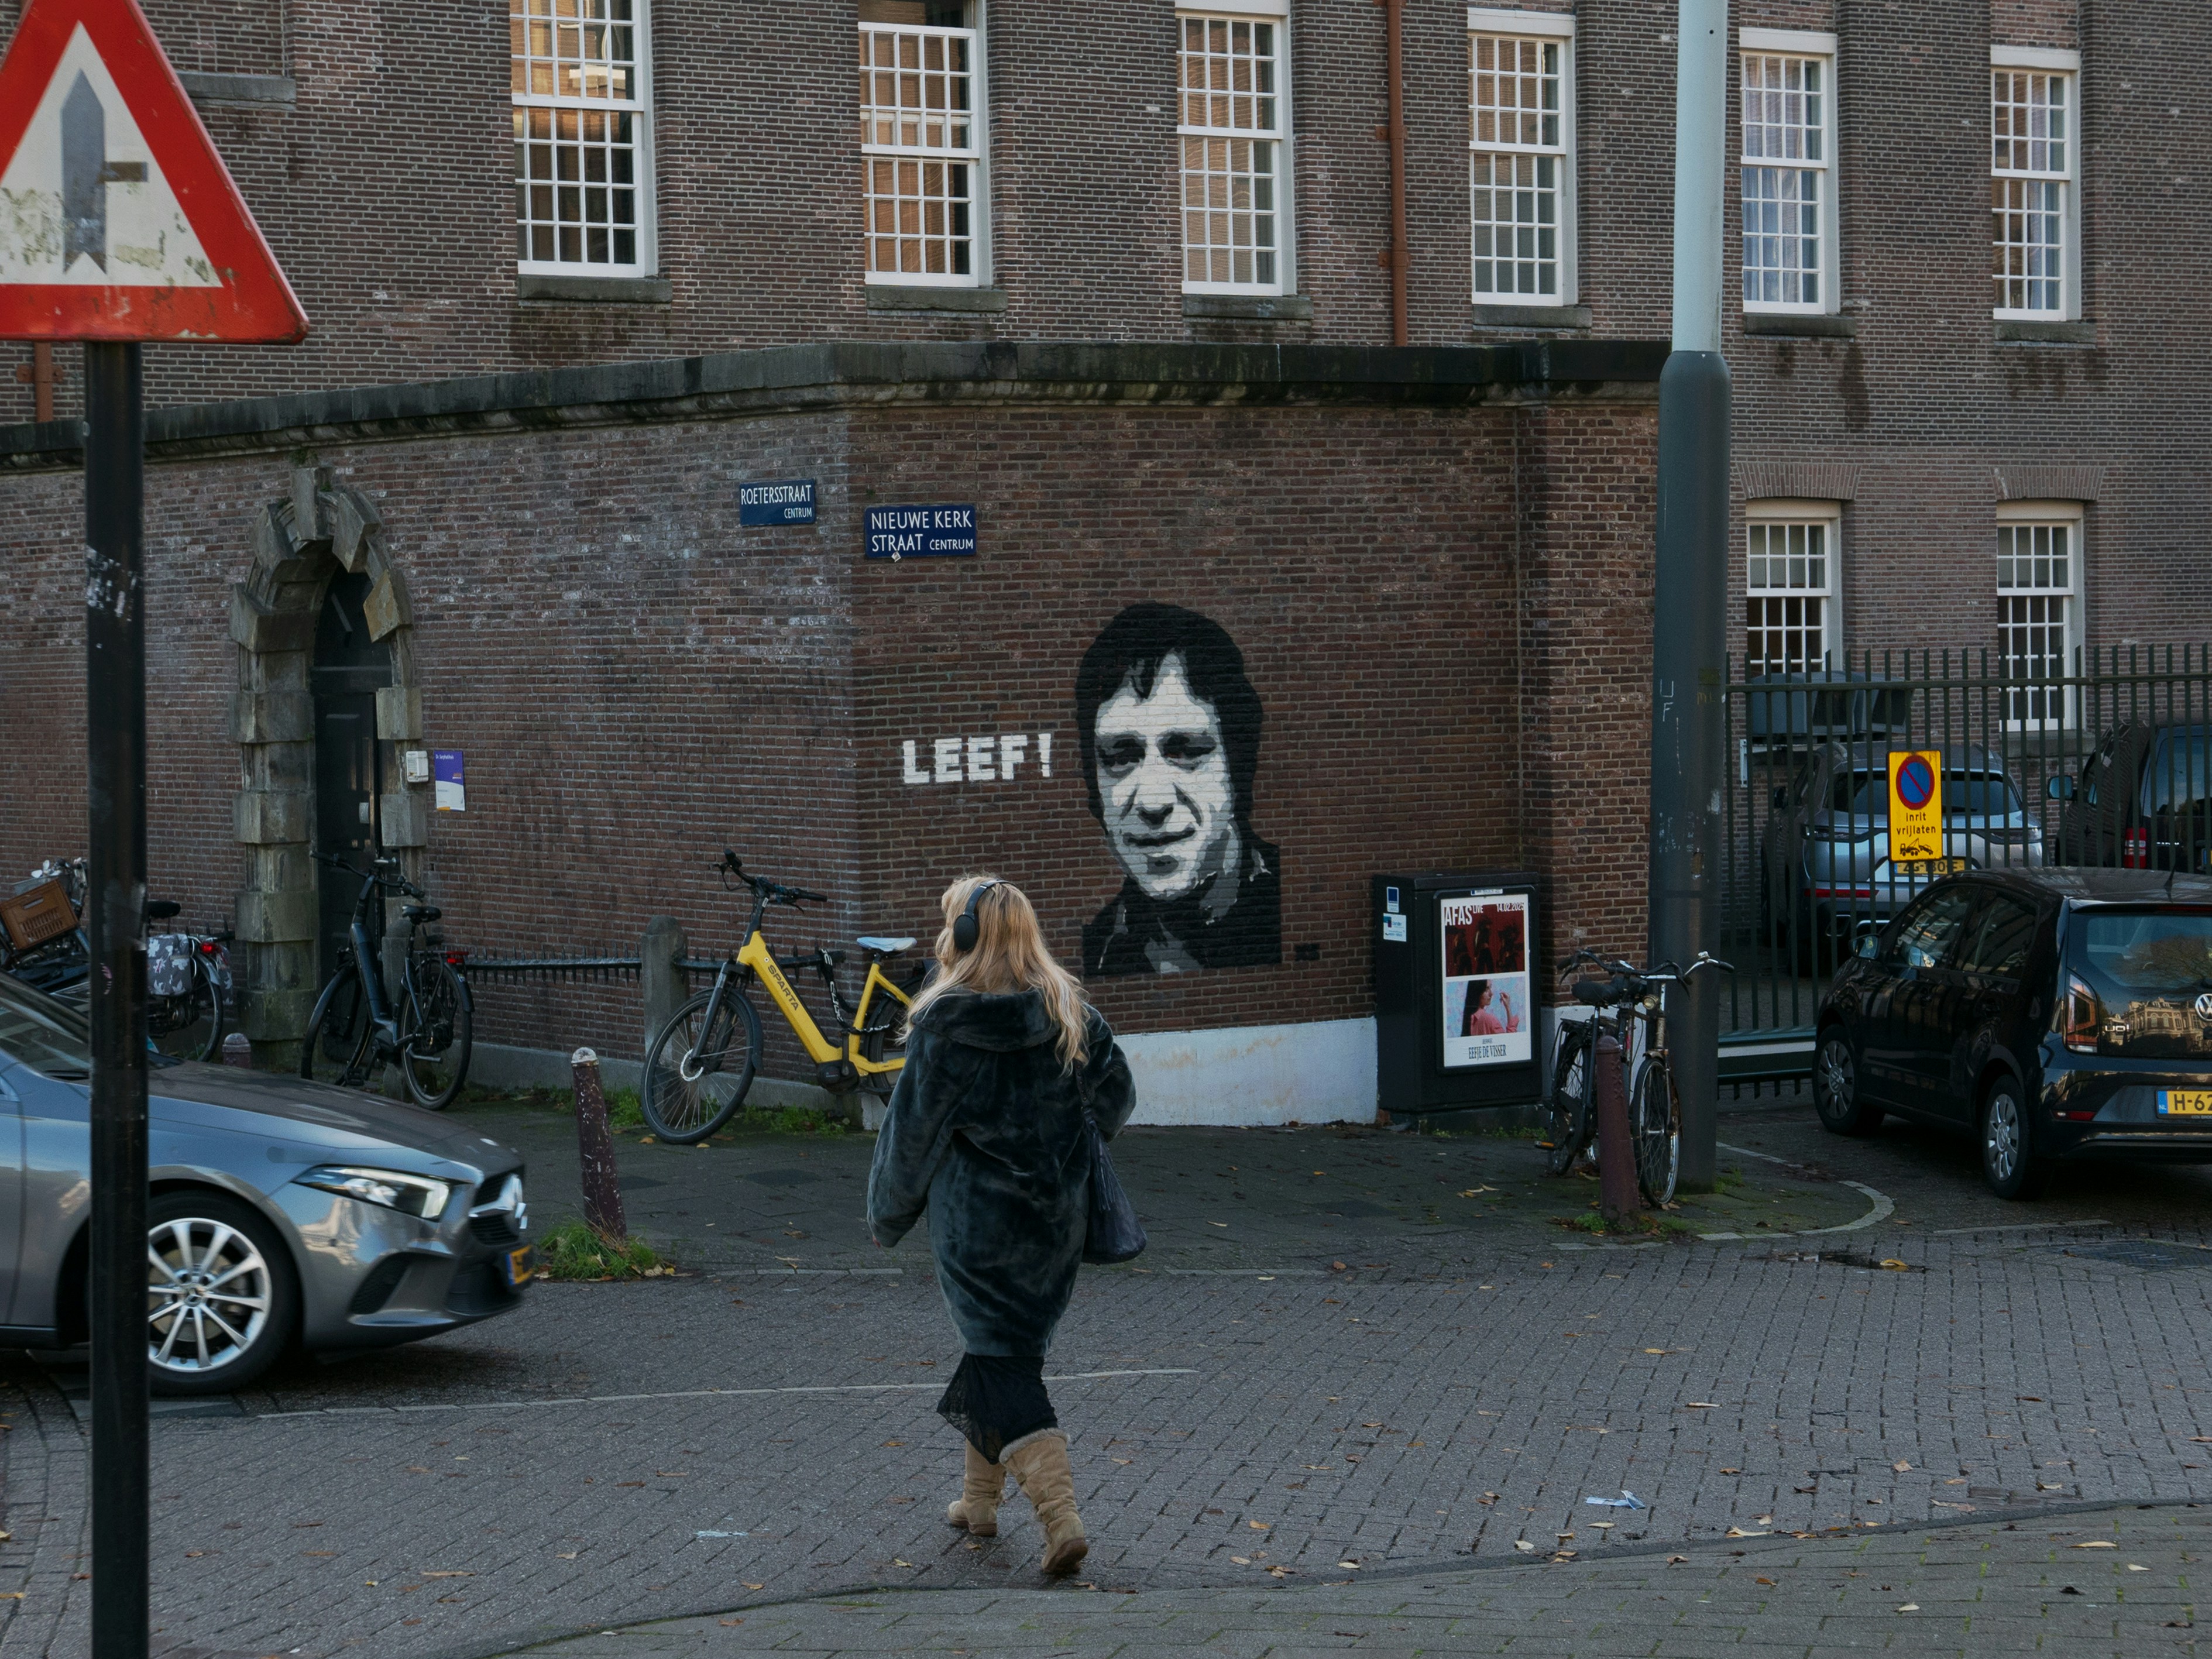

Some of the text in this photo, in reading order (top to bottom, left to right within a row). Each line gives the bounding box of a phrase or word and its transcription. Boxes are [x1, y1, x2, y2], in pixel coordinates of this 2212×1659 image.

[741, 485, 812, 504] ROETERSSTRAAT
[784, 507, 812, 519] CENTRUM
[871, 510, 972, 530] NIEUWE KERK
[871, 534, 974, 552] STRAAT CENTRUM
[1905, 812, 1926, 822] inrit
[1896, 825, 1936, 837] vrijlaten
[1445, 905, 1484, 926] AFAS LIVE
[768, 964, 799, 1011] SPARTA
[1482, 1046, 1489, 1059] DE
[1489, 1044, 1507, 1058] VISSER
